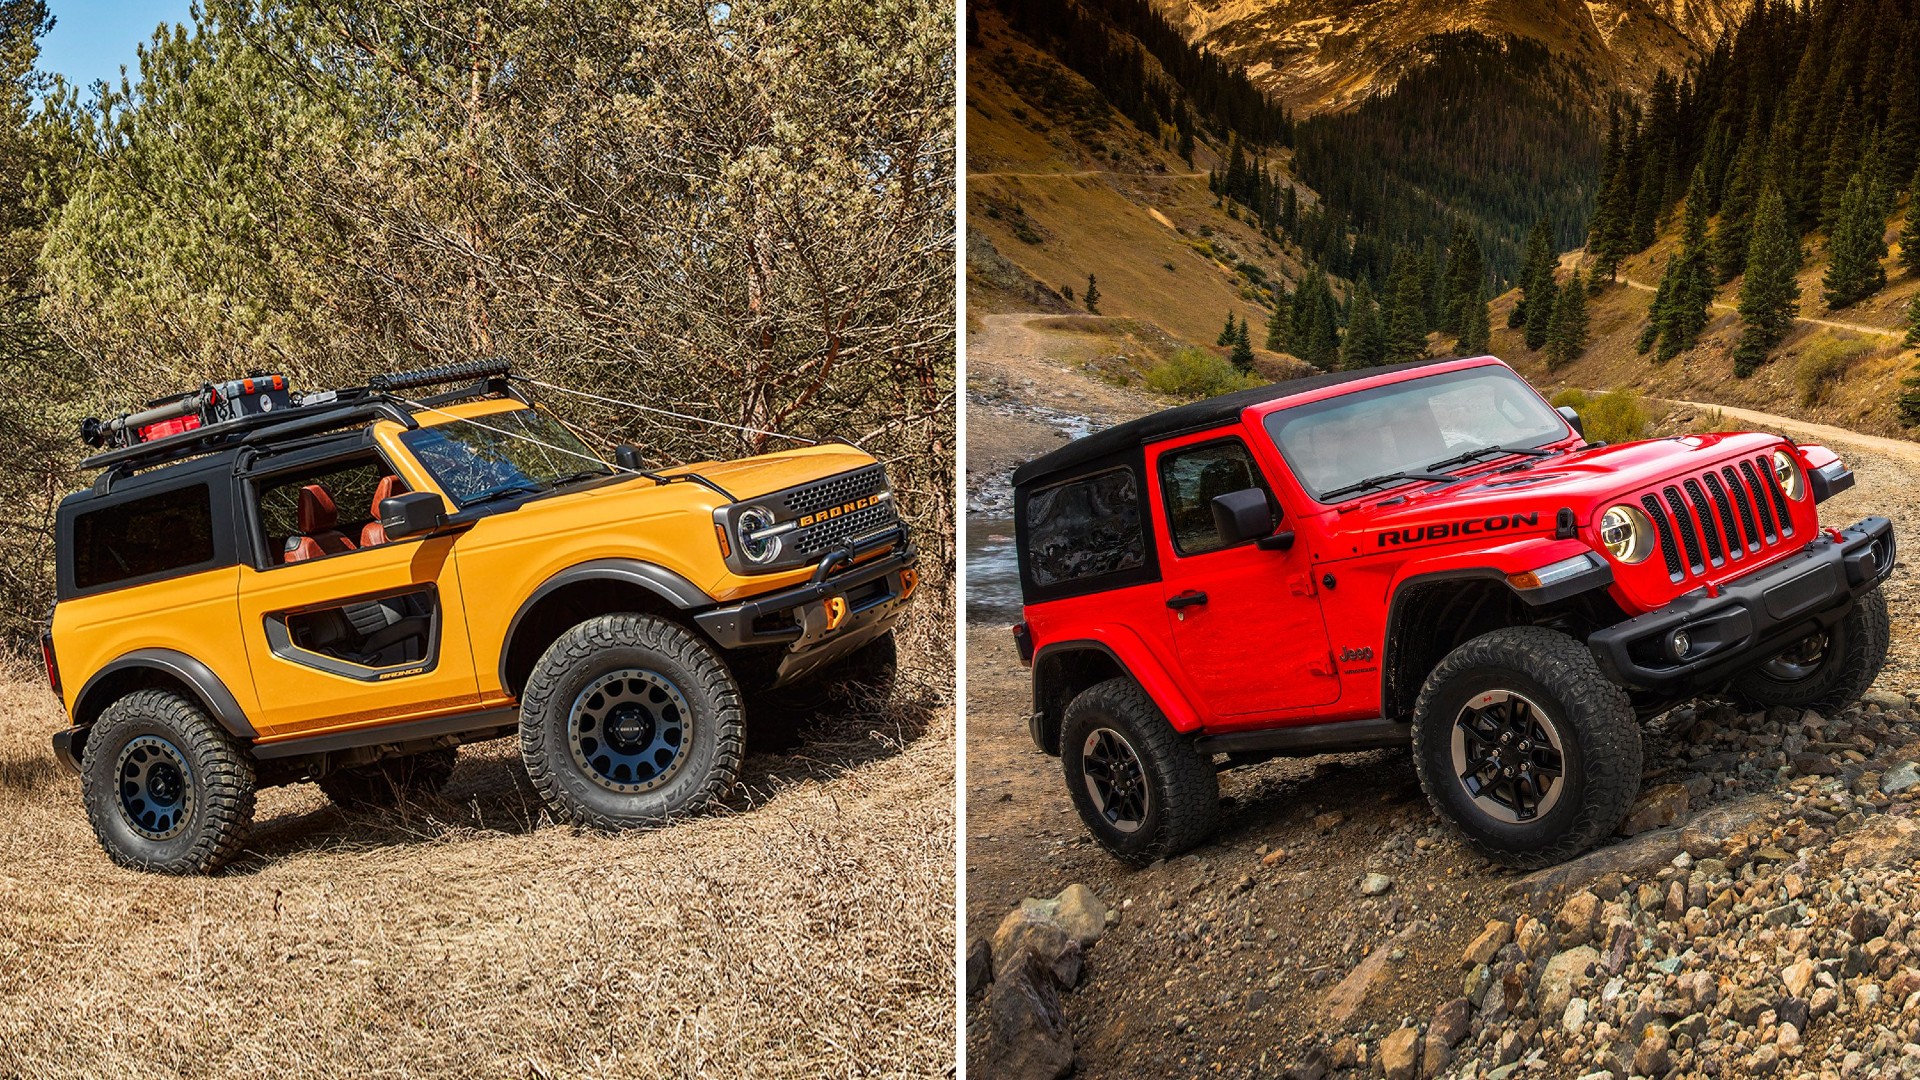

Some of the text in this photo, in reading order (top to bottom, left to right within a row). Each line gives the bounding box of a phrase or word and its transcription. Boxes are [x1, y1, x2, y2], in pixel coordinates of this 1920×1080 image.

[800, 496, 879, 526] BRONCO
[1378, 512, 1538, 547] RUBICON
[1340, 645, 1374, 662] Jeep
[379, 668, 422, 680] BRONCO
